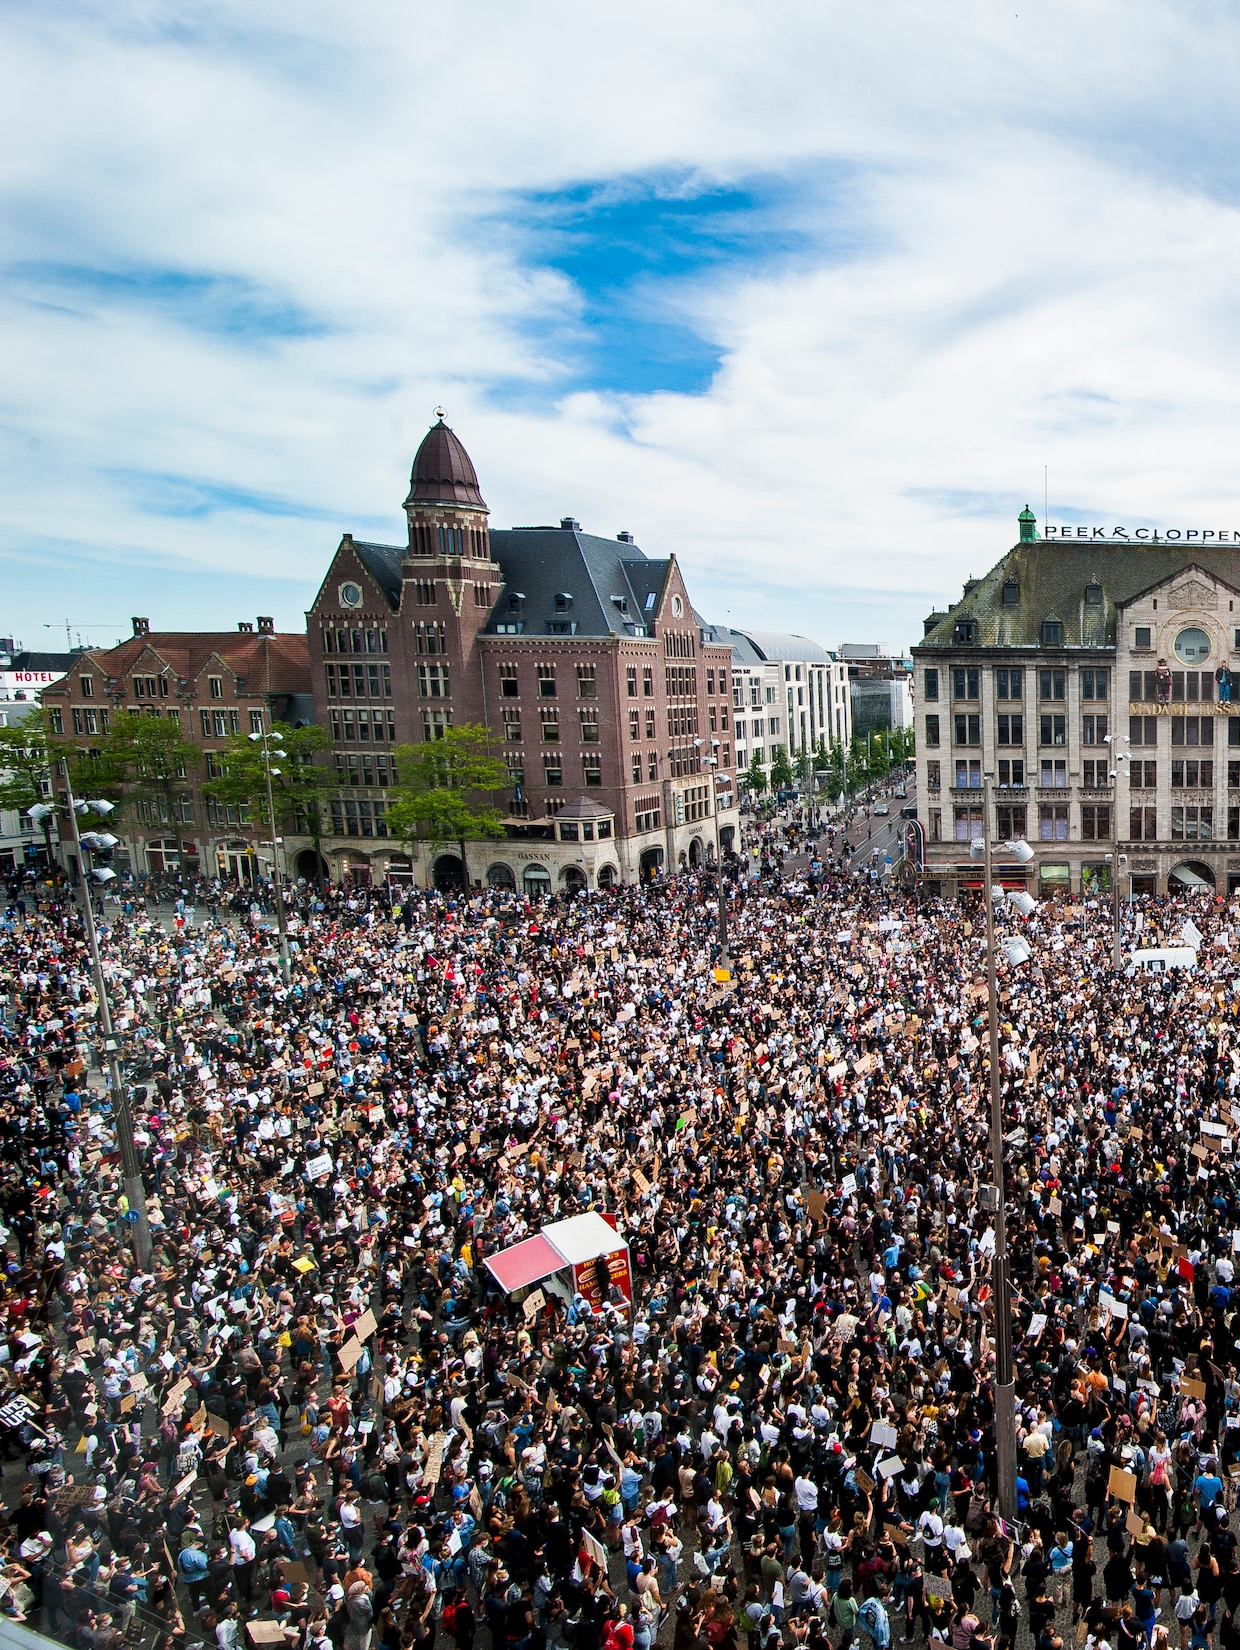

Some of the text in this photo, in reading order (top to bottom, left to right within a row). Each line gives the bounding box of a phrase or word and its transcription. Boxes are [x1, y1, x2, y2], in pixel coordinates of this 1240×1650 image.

[1046, 526, 1105, 538] PEEK
[1112, 527, 1130, 538] &
[15, 672, 55, 682] HOTEL
[1129, 703, 1192, 716] MADAME
[517, 852, 550, 861] GASSAN
